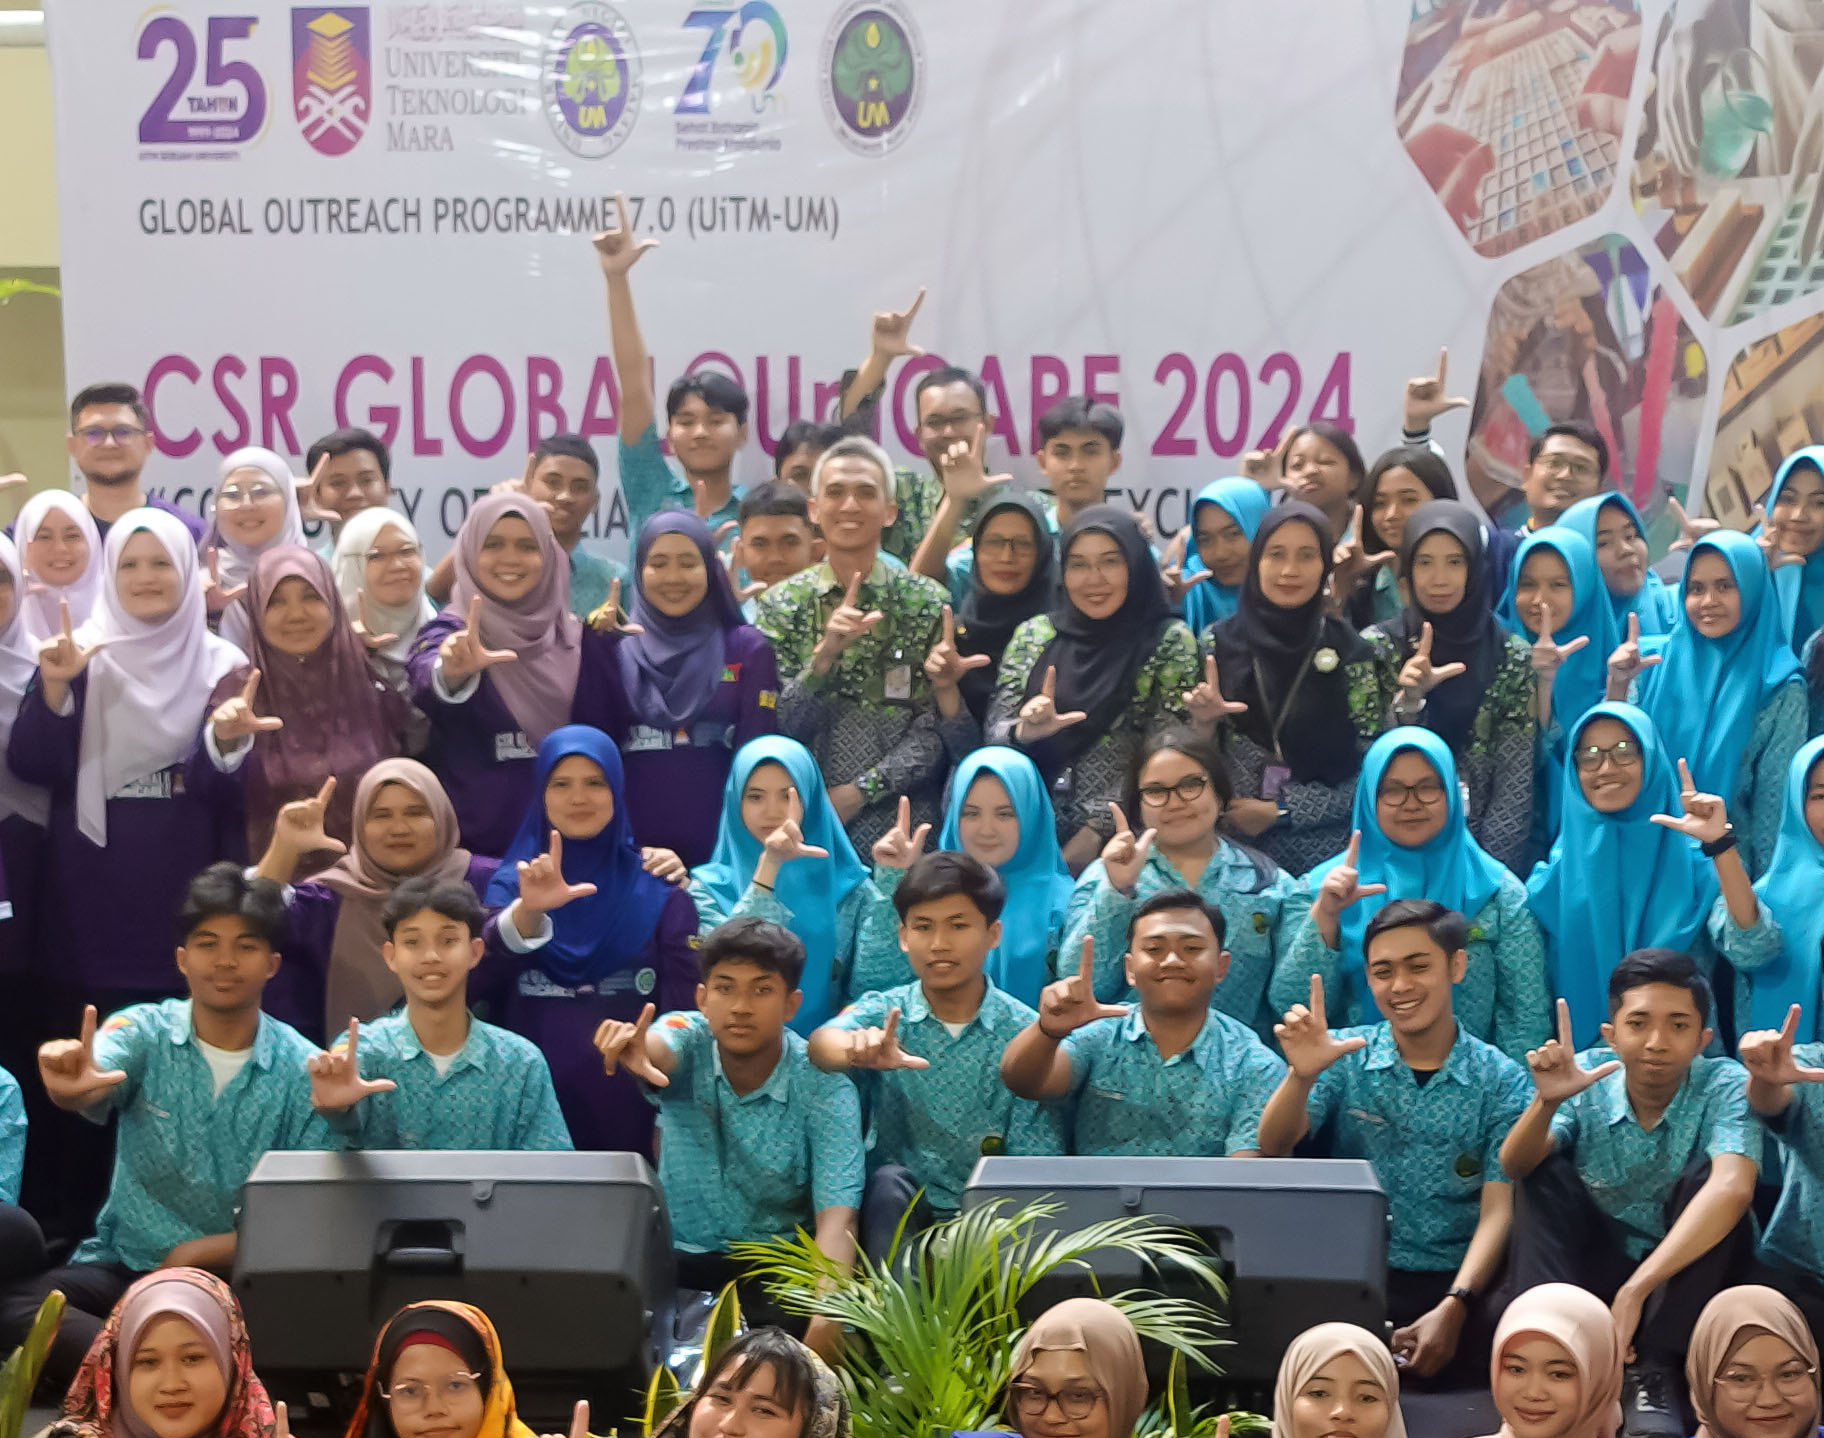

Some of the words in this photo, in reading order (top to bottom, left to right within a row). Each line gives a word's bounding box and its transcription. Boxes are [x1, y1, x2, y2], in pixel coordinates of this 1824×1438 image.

[137, 16, 266, 143] 25
[578, 105, 608, 129] UM
[856, 101, 891, 129] UM
[387, 121, 455, 152] MARA
[139, 198, 254, 234] GLOBAL
[264, 198, 422, 234] OUTREACH
[433, 197, 618, 233] PROGRAMME
[627, 196, 675, 233] 7.0
[687, 195, 839, 240] (UiTM-UM)
[142, 354, 301, 458] CSR
[1151, 351, 1356, 458] 2024
